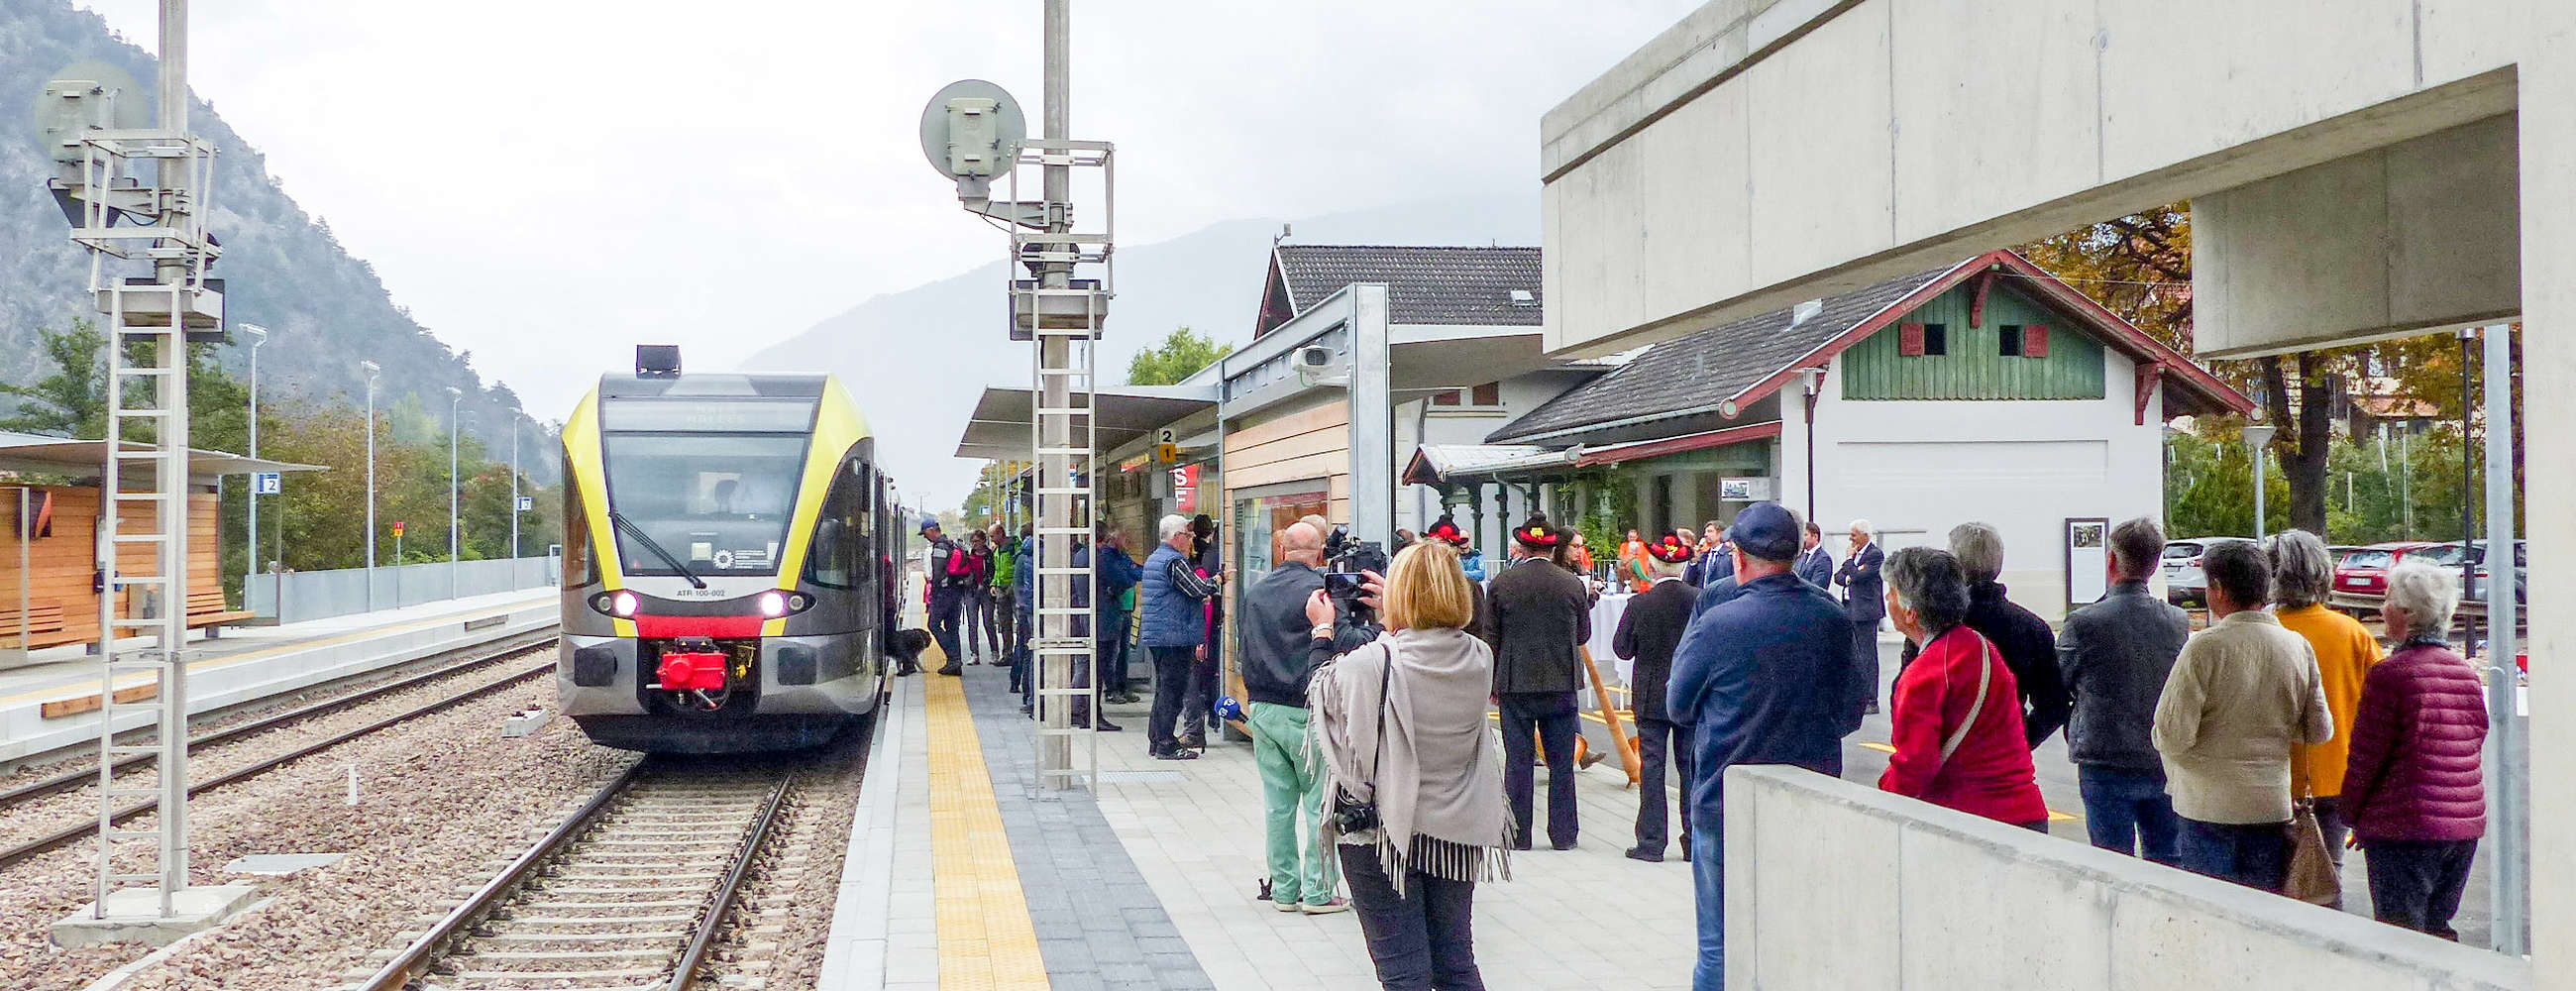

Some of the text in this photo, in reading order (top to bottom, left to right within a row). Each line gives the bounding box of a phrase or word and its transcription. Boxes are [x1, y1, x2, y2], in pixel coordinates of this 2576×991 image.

[1162, 430, 1172, 442] 2
[1164, 448, 1170, 458] 1
[1173, 468, 1188, 487] S
[268, 480, 276, 491] 2
